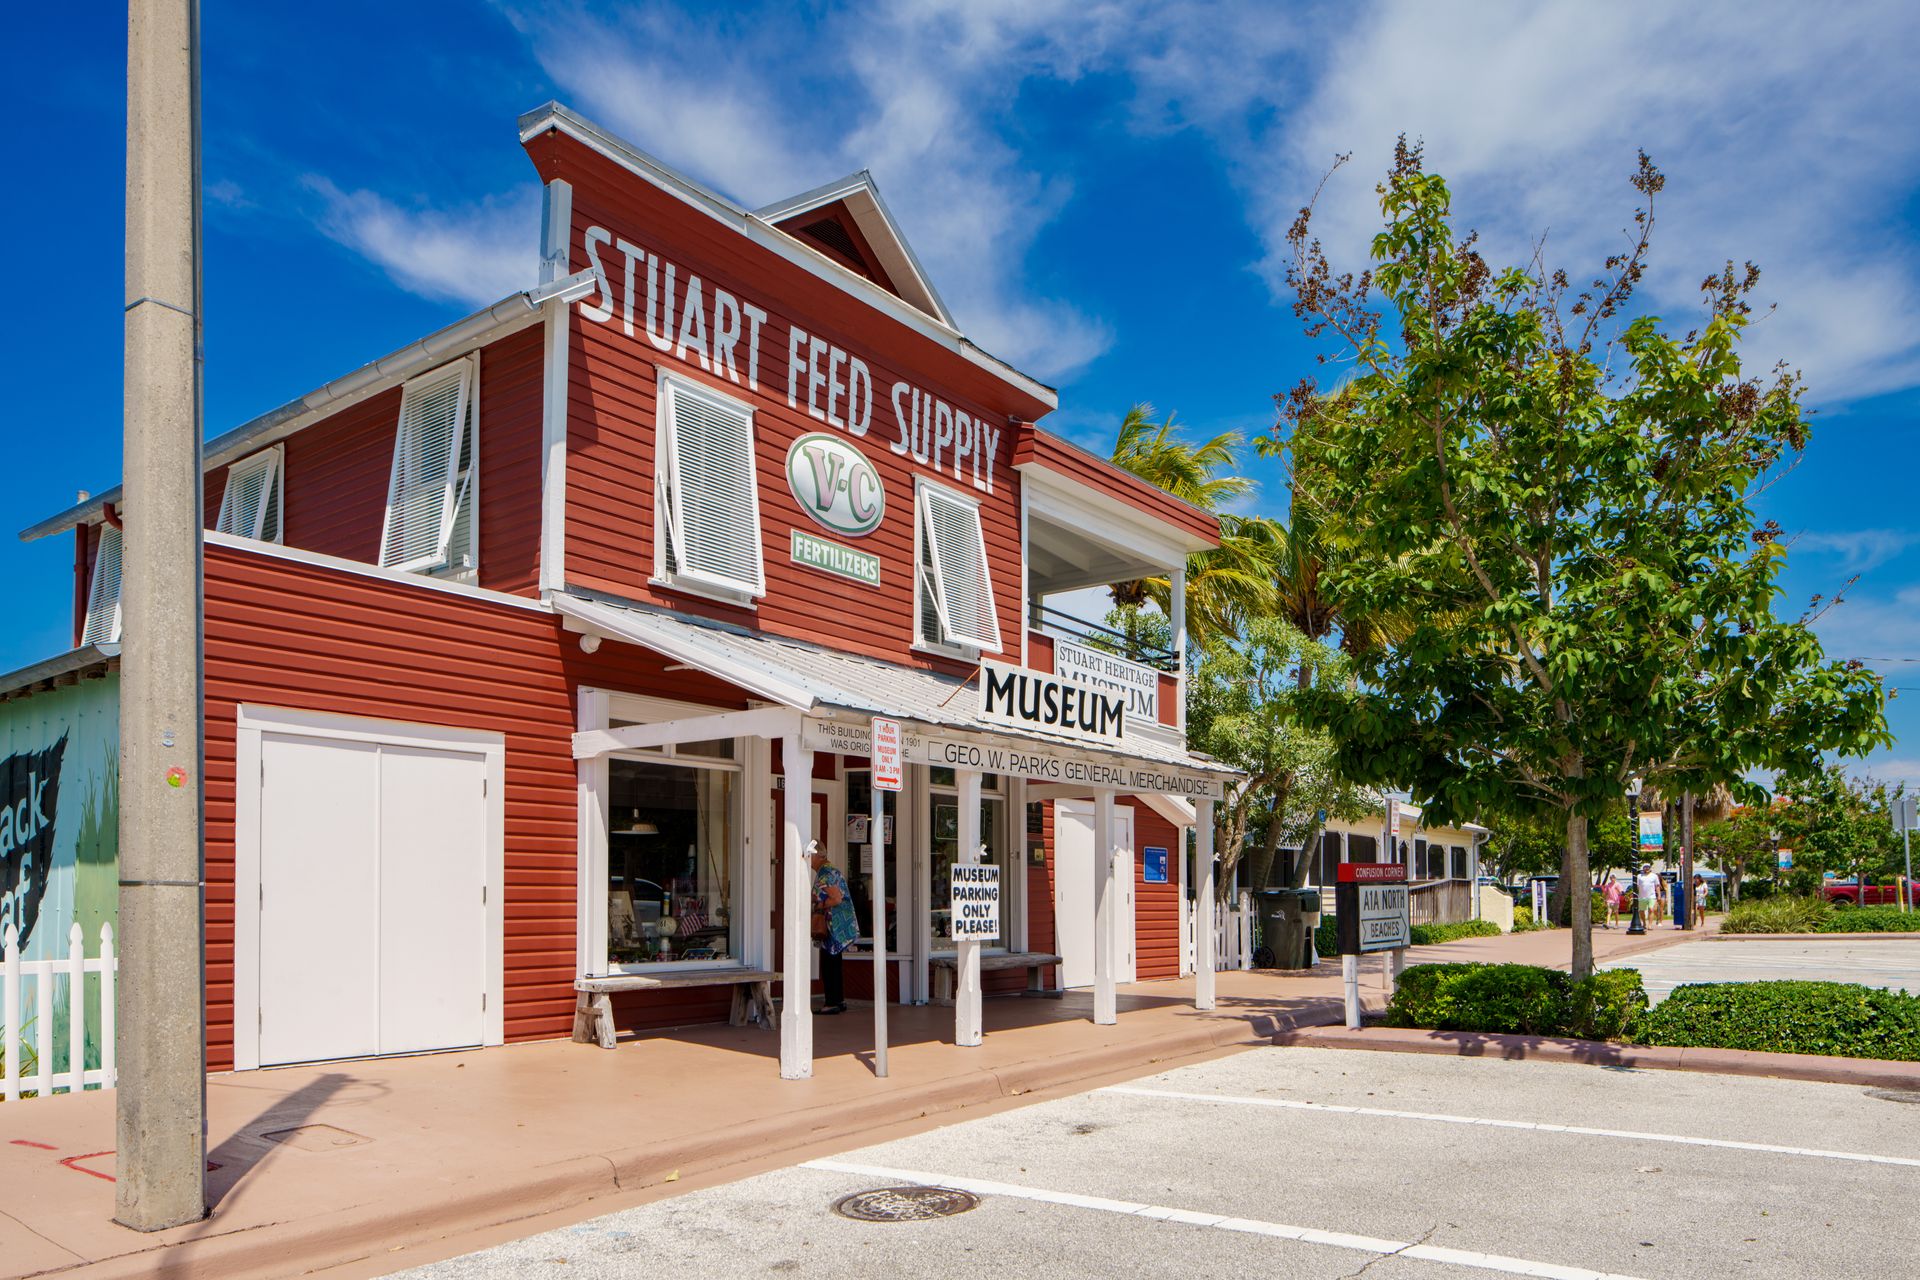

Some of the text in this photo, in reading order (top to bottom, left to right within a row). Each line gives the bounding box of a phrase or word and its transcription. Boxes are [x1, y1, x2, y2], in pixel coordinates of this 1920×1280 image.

[579, 225, 1000, 494] STUART FEED SUPPLY
[795, 536, 877, 580] FERTILIZERS
[1059, 646, 1155, 688] STUART HERITAGE
[985, 667, 1125, 738] MUSEUM
[817, 723, 836, 736] THIS
[906, 737, 920, 748] 1901
[878, 733, 897, 744] PARKING
[830, 738, 849, 750] WAS
[877, 745, 897, 755] MUSEUM
[881, 755, 893, 764] ONLY
[944, 743, 1209, 796] GEO. W. PARKS GENERAL MERCHANDISE
[953, 868, 999, 883] MUSEUM
[1355, 866, 1404, 878] CONFUSION CORNER
[953, 887, 998, 901] PARKING
[1363, 889, 1405, 911] A1A NORTH
[963, 904, 991, 918] ONLY
[955, 919, 998, 934] PLEASE!
[1370, 921, 1400, 938] BEACHES
